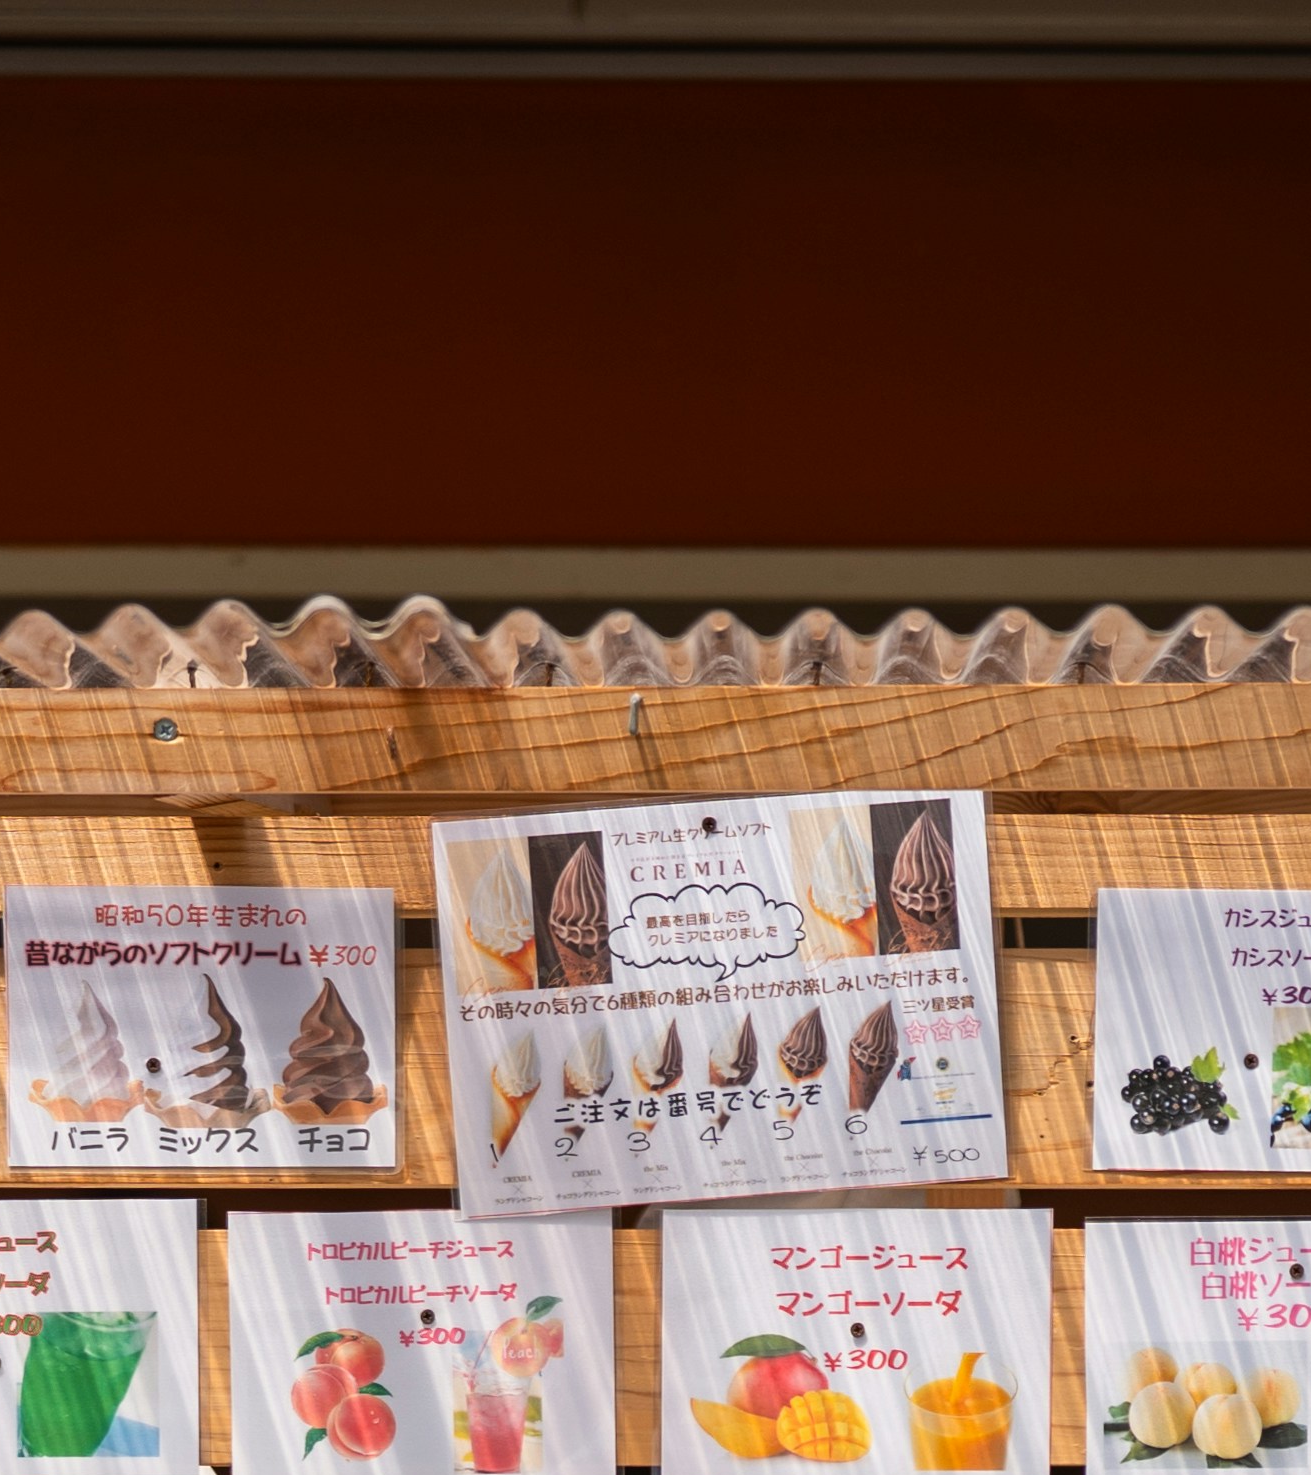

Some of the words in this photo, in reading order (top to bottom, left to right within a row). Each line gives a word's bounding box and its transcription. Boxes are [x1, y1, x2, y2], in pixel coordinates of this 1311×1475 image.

[631, 860, 746, 882] CREMIA
[96, 904, 306, 928] 昭和50年生まれの
[646, 910, 750, 930] 最高を目指したら
[648, 926, 778, 947] クレミアになりました
[26, 941, 301, 967] 昔ながらのソフトクリーム
[554, 1085, 822, 1123] ご注文は番号でどうぞ
[52, 1128, 128, 1152] バニラ
[160, 1128, 259, 1154] ミックス
[299, 1127, 370, 1152] チョコ
[308, 1240, 515, 1261] トロピカルピーチジュース
[770, 1245, 968, 1270] マンゴージュース
[326, 1283, 518, 1305] トロピカルピーチソーダ
[776, 1290, 963, 1316] マンゴーソーダ
[400, 1328, 465, 1347] ¥300
[824, 1349, 908, 1371] ¥300
